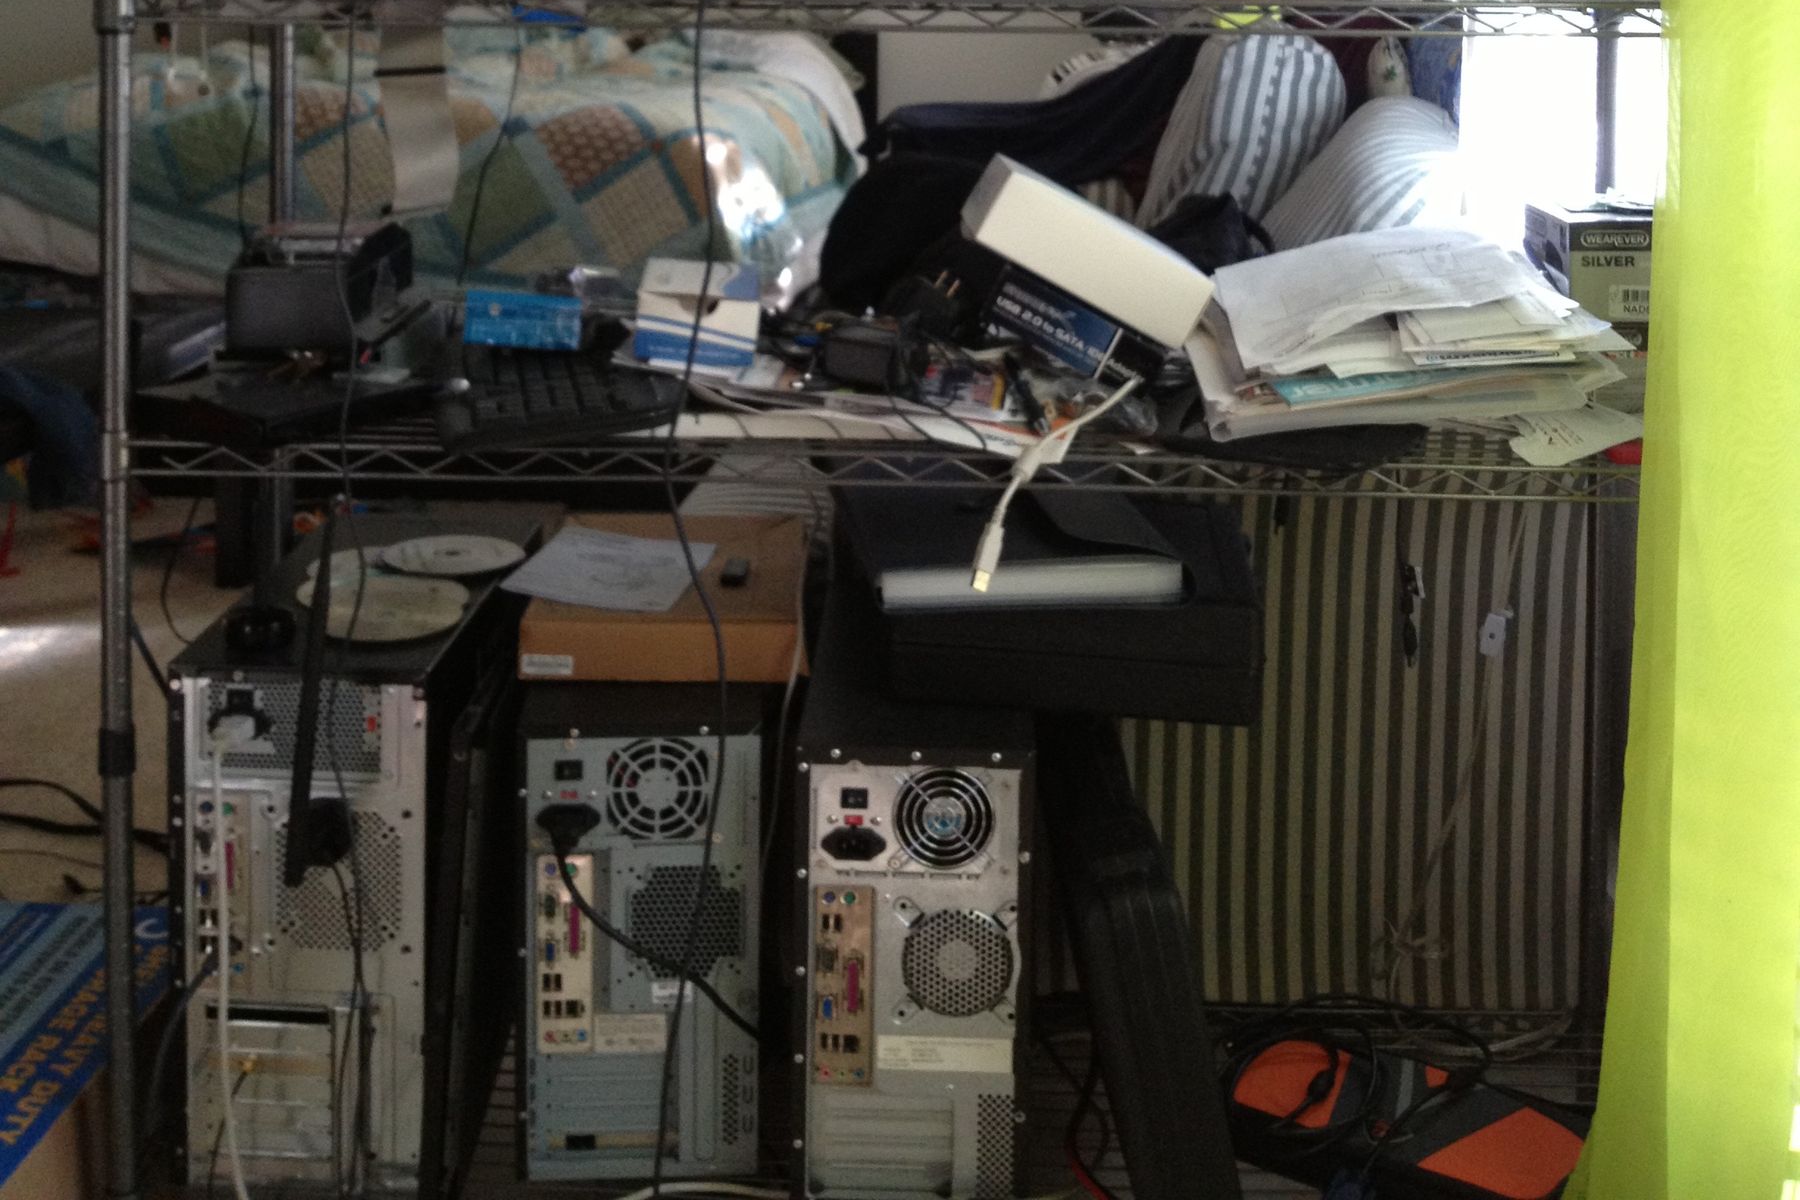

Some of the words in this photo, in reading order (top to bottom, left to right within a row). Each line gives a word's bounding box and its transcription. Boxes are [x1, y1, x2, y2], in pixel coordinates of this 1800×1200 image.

[1585, 231, 1646, 246] WEAREVER
[1581, 255, 1635, 267] SILVER
[1623, 304, 1650, 314] NAD
